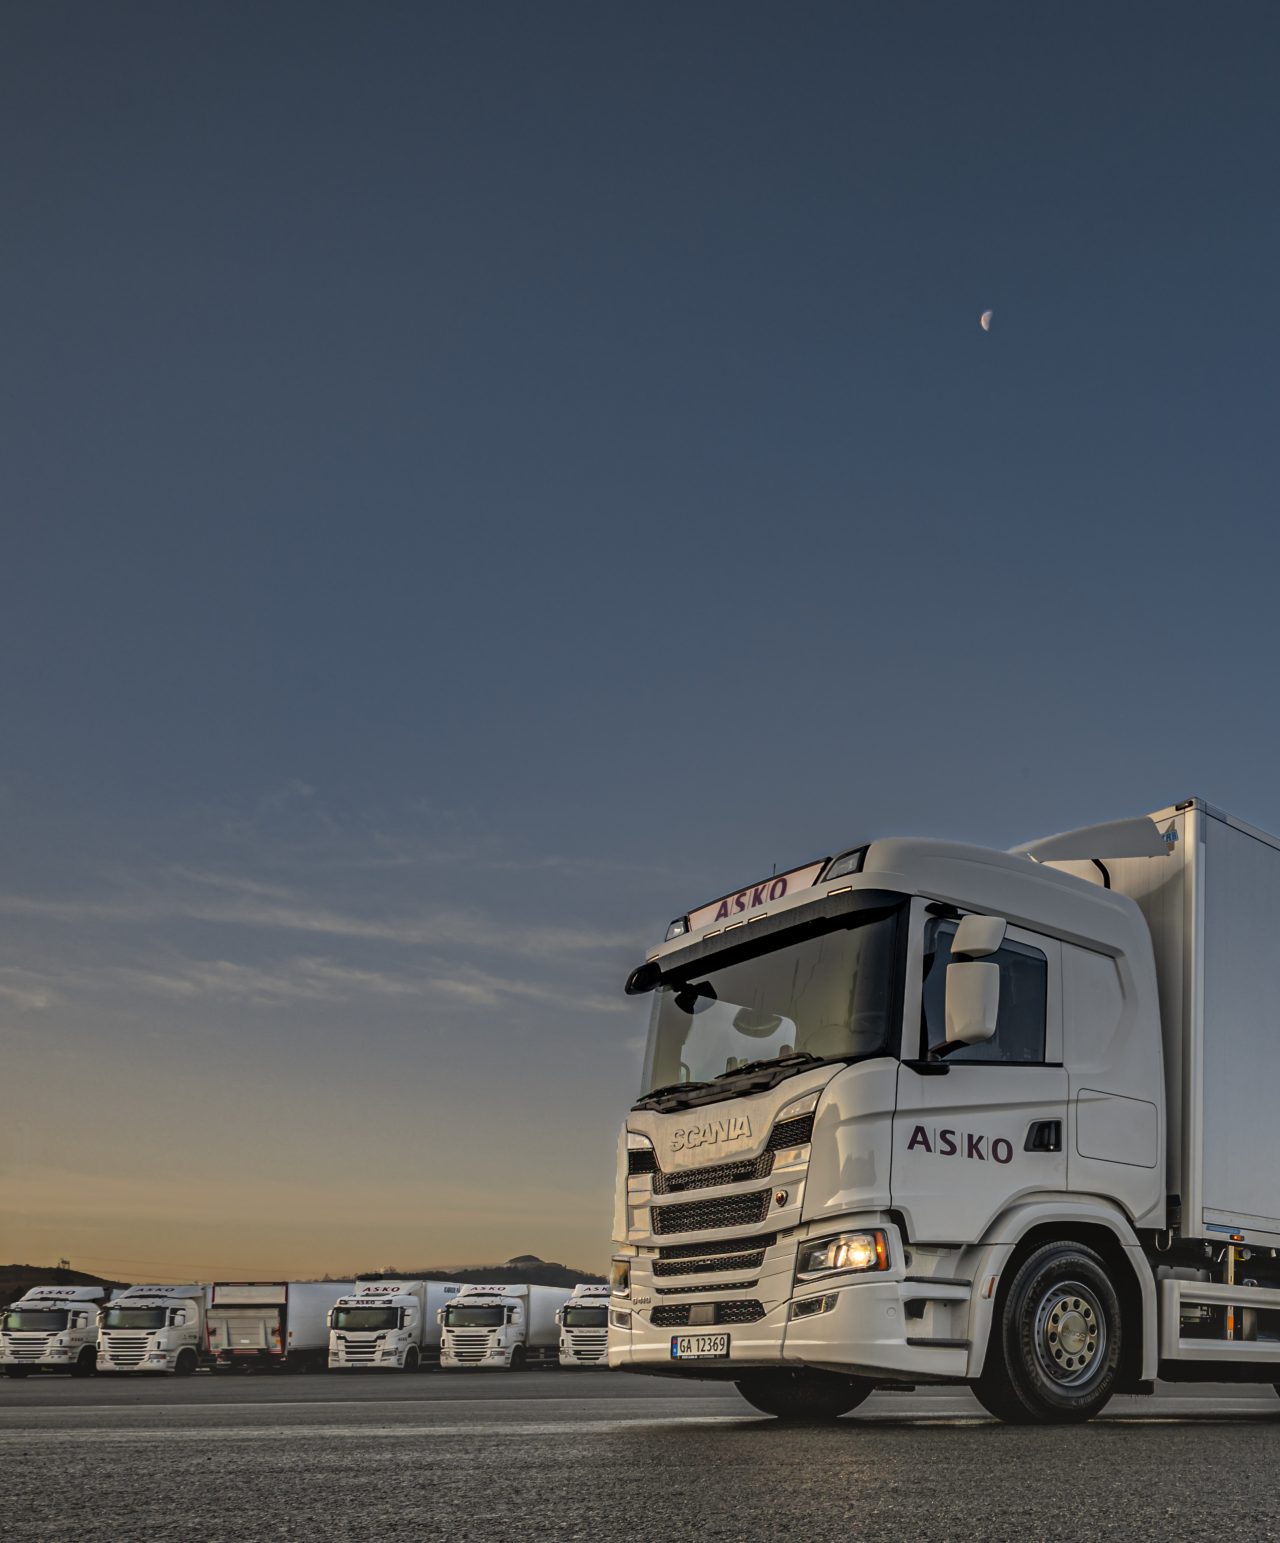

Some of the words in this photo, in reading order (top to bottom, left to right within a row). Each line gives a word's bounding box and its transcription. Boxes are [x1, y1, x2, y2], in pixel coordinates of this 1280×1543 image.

[714, 877, 788, 922] ASKO
[671, 1115, 752, 1153] SCANIA
[907, 1125, 1013, 1164] ASKO
[679, 1338, 692, 1353] GA
[696, 1336, 725, 1353] 12369
